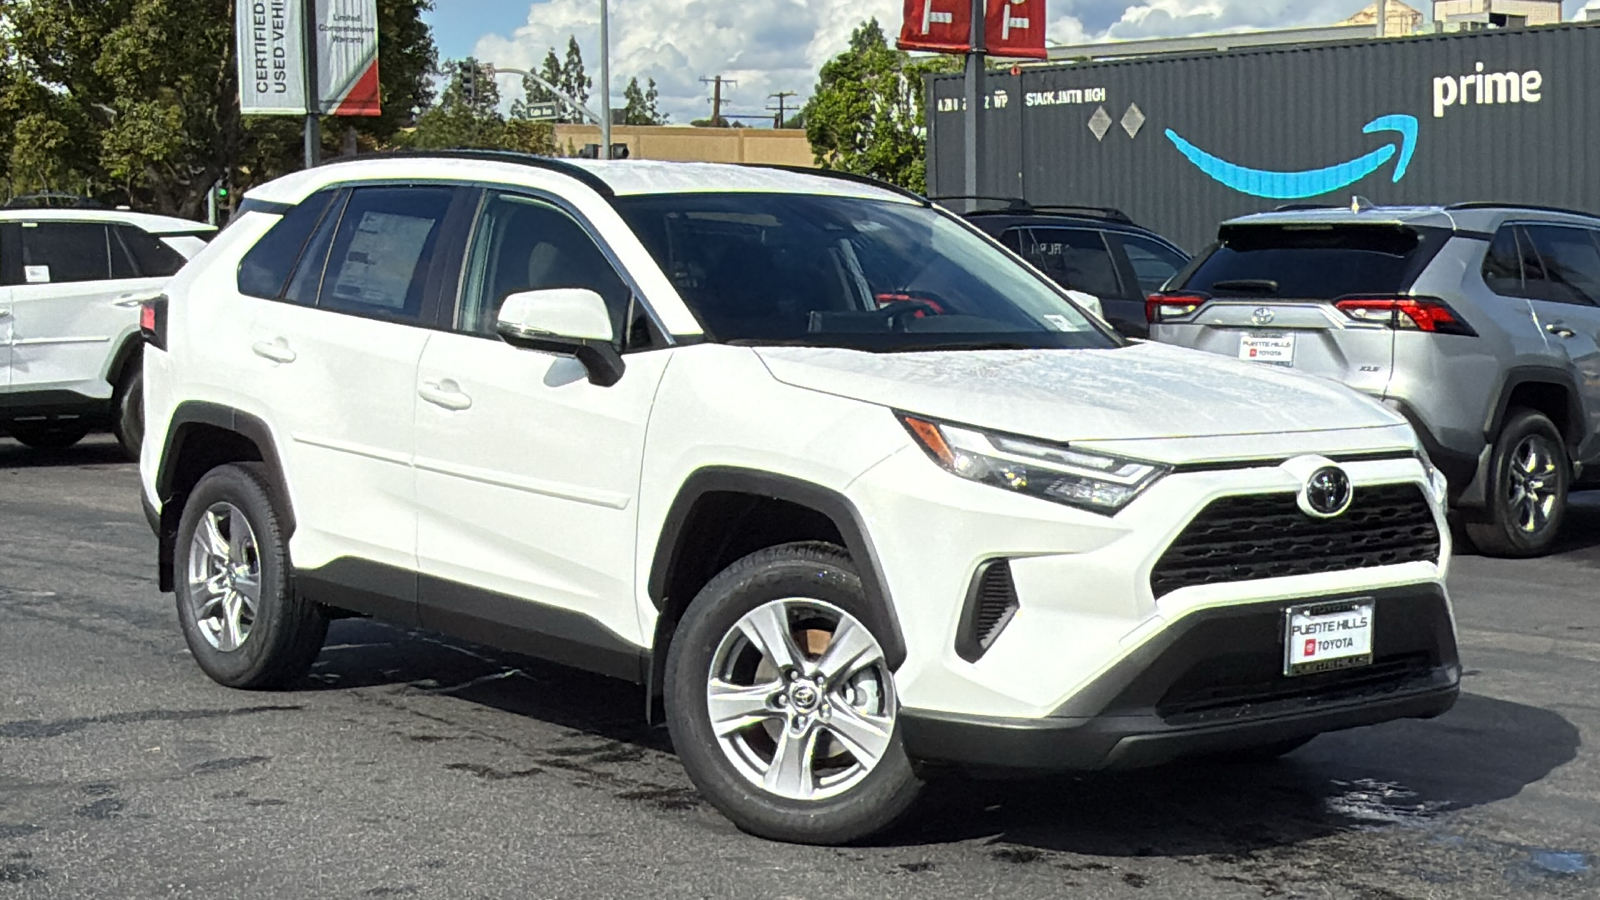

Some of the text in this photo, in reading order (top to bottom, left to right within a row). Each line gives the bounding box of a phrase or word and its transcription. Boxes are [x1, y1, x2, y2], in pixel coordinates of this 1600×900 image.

[333, 14, 361, 22] Limited
[318, 23, 375, 34] Comprehensive
[253, 2, 268, 93] CERTIFIED
[272, 0, 286, 93] USED VEHI
[332, 35, 364, 44] Warranty
[1433, 62, 1542, 117] prime
[1292, 617, 1367, 636] PUENTE HILLS
[1317, 637, 1353, 651] TOYOTA
